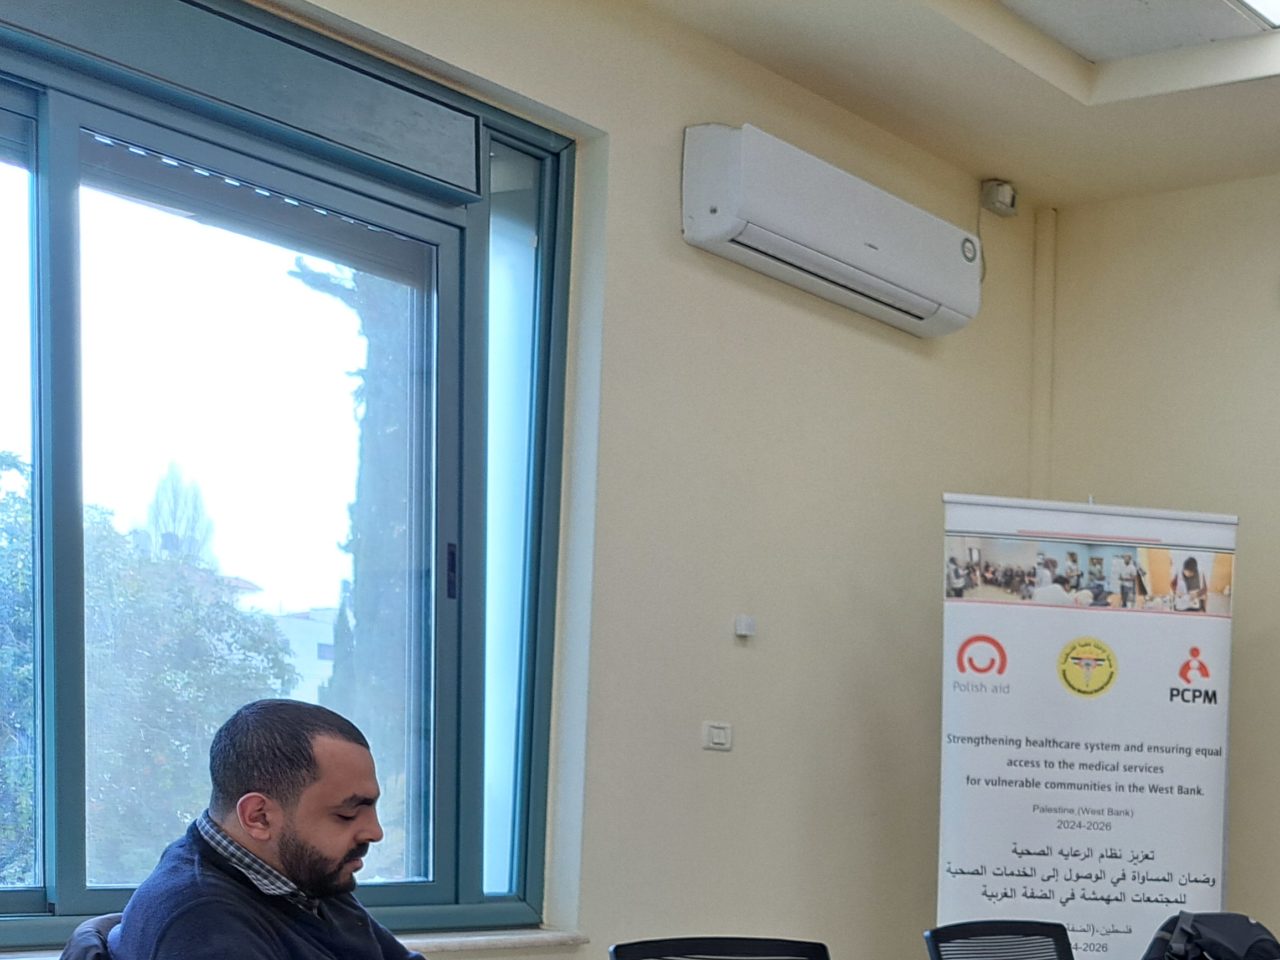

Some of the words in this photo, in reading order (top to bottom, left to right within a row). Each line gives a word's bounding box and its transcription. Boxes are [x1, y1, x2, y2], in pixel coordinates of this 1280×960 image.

[952, 680, 988, 694] Polish
[990, 683, 1011, 695] aid
[1169, 687, 1218, 705] PCPM
[946, 733, 1023, 749] Strengthening
[1025, 736, 1081, 750] healthcare
[1084, 742, 1121, 753] system
[1123, 742, 1144, 753] and
[1147, 743, 1192, 757] ensuring
[1194, 746, 1222, 758] equal
[1006, 758, 1041, 769] access
[1044, 759, 1055, 769] to
[1058, 759, 1075, 771] the
[1079, 760, 1120, 773] medical
[1122, 762, 1165, 774] services
[966, 774, 981, 787] for
[984, 776, 1041, 789] vulnerable
[1044, 779, 1112, 793] communities
[1115, 781, 1125, 793] in
[1128, 782, 1145, 794] the
[1148, 784, 1174, 795] West
[1177, 785, 1205, 797] Bank.
[1107, 807, 1135, 818] Bank)
[1056, 819, 1112, 832] 2024-2026
[1011, 842, 1053, 859] الصحية
[1098, 847, 1122, 864] نظام
[1127, 849, 1156, 866] تعزيز
[946, 861, 987, 879] الصحية
[992, 866, 1037, 878] الخدمات
[1040, 867, 1059, 883] إلى
[1063, 867, 1106, 883] الوصول
[1110, 868, 1127, 887] في
[1131, 869, 1174, 885] المساواة
[1178, 872, 1217, 887] وضمان
[981, 884, 1017, 904] الغربية
[1021, 885, 1055, 901] الضفة
[1059, 887, 1076, 907] في
[1080, 887, 1126, 905] المهمشة
[1131, 892, 1187, 907] للمجتمعات
